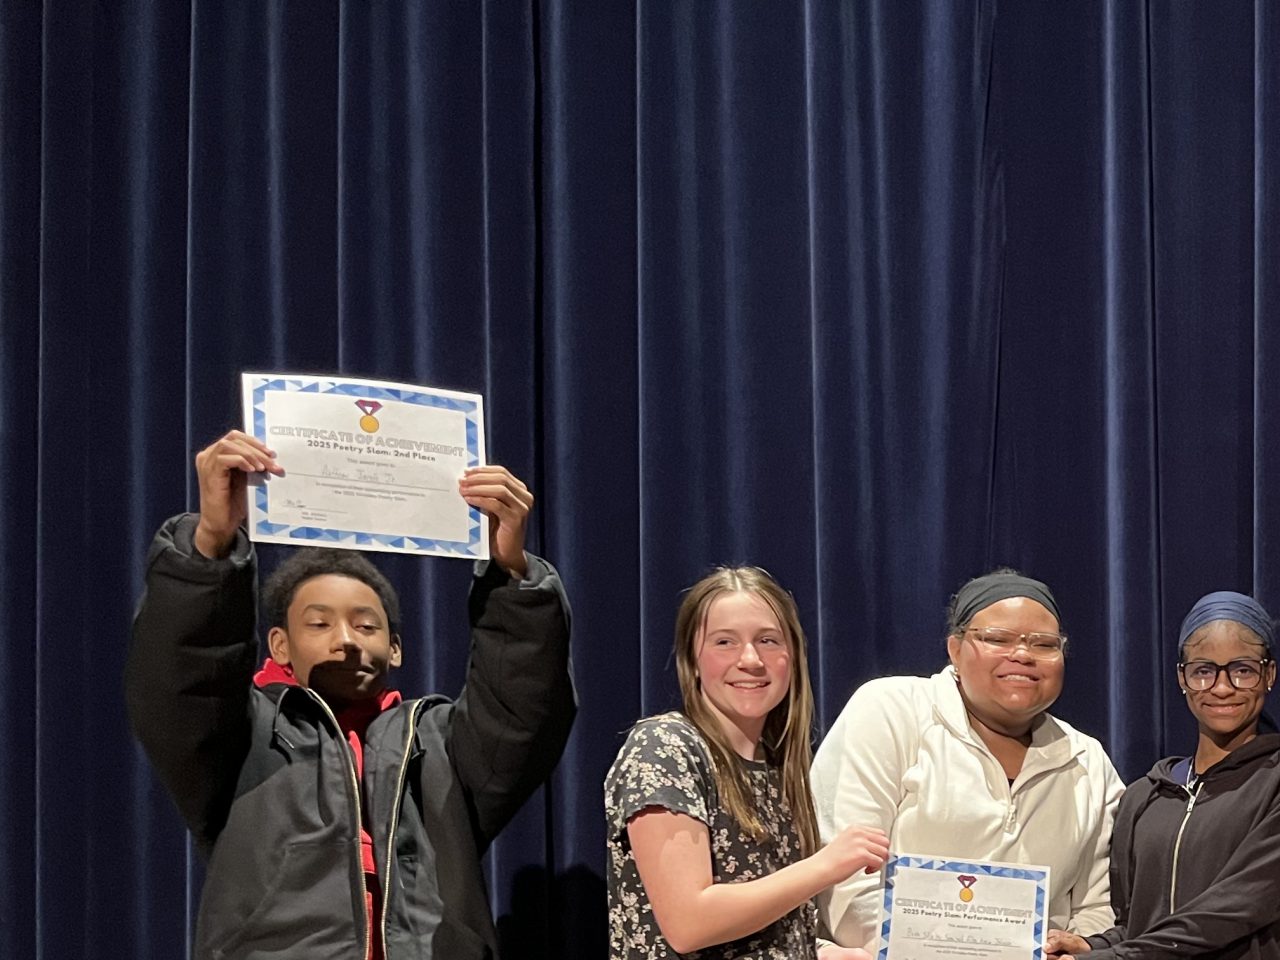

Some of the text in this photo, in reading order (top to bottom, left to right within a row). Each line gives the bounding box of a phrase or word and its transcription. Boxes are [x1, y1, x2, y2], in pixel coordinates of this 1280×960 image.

[269, 425, 464, 457] CERTIFICATE OF ACHIEVEMENT
[307, 439, 331, 449] 2025
[333, 443, 363, 454] Poetry
[394, 449, 410, 458] 2nd
[894, 897, 1033, 919] CERTIFICATE OF ACHIEVEMENT
[902, 907, 920, 915] 2025
[920, 909, 942, 918] Poetry
[963, 913, 1003, 923] Performance
[1004, 916, 1026, 925] Award
